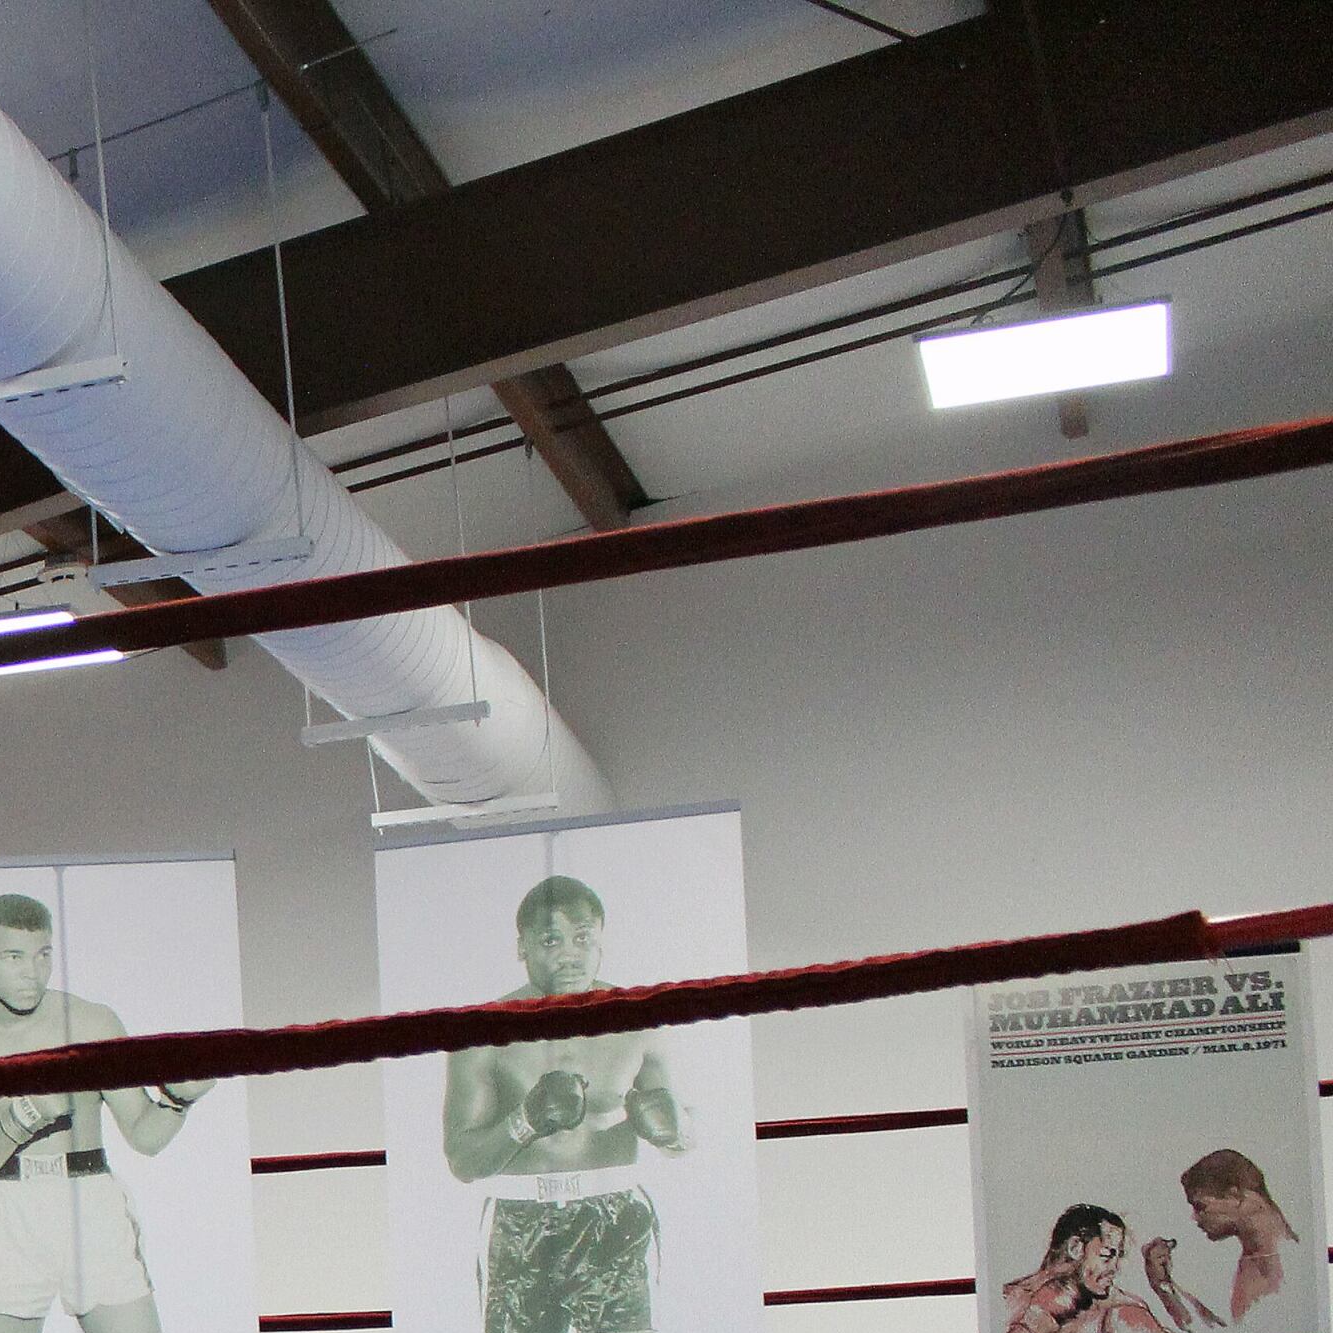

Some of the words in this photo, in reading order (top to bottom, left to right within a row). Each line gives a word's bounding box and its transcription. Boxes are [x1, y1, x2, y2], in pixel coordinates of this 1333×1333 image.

[988, 990, 1049, 1012] JOE
[1060, 975, 1217, 1006] FRAZIER
[1224, 971, 1284, 992] VS.
[989, 998, 1215, 1032] MUHAMMAD
[1219, 991, 1285, 1015] ALI
[991, 1038, 1043, 1050] WORLD
[1047, 1029, 1162, 1047] HEAVYWEIGHT
[1165, 1021, 1286, 1037] CHAMPIONSHIP
[991, 1056, 1062, 1068] MADISON
[1064, 1052, 1122, 1065] SQUARE
[1126, 1046, 1189, 1060] GARDEN
